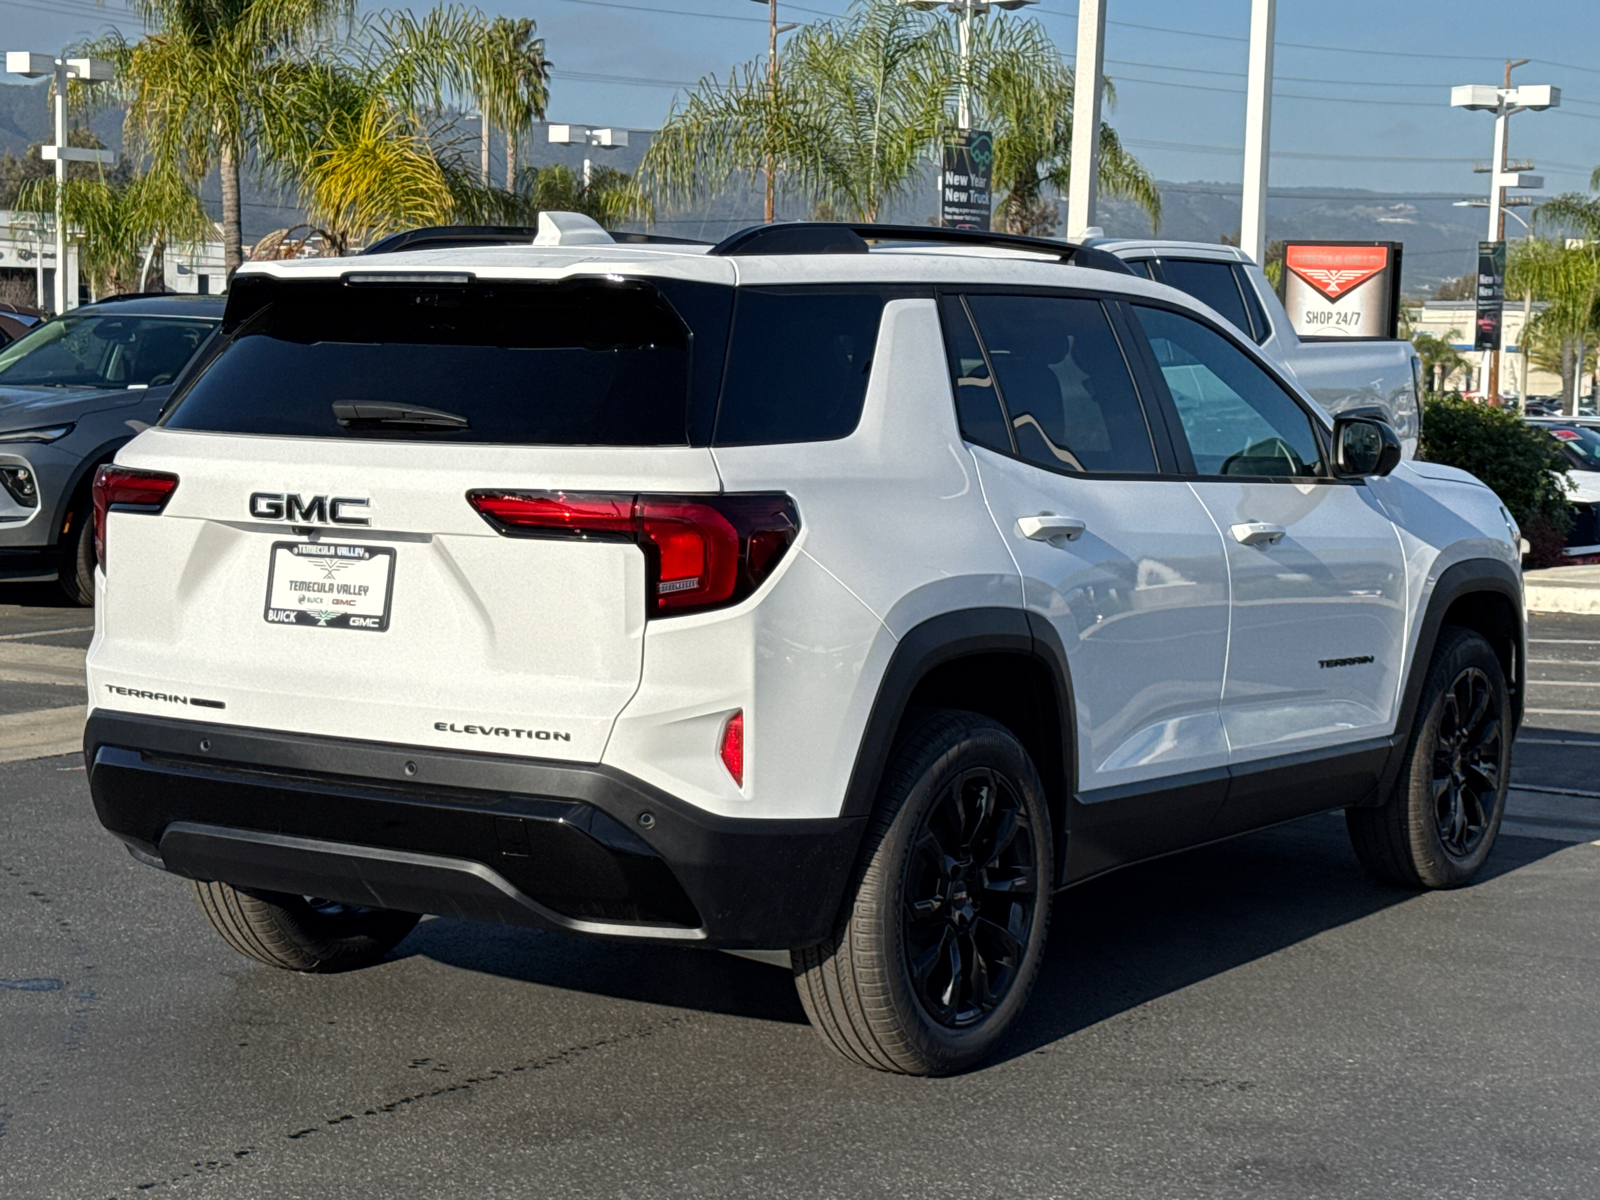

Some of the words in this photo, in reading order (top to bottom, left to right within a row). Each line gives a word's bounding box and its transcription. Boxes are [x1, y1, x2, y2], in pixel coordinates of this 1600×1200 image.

[945, 171, 968, 186] New
[944, 188, 968, 202] New
[1305, 311, 1333, 325] SHOP
[1335, 312, 1361, 326] 24/7
[249, 491, 371, 527] GMC
[298, 544, 335, 556] TEMECULA
[336, 546, 364, 558] VALLEY
[289, 580, 334, 594] TEMECULA
[336, 583, 369, 596] VALLEY
[331, 598, 357, 607] GMC
[268, 610, 298, 623] BUICK
[349, 617, 380, 628] GMC
[104, 684, 188, 705] TERRAIN
[433, 721, 571, 742] ELEVATION
